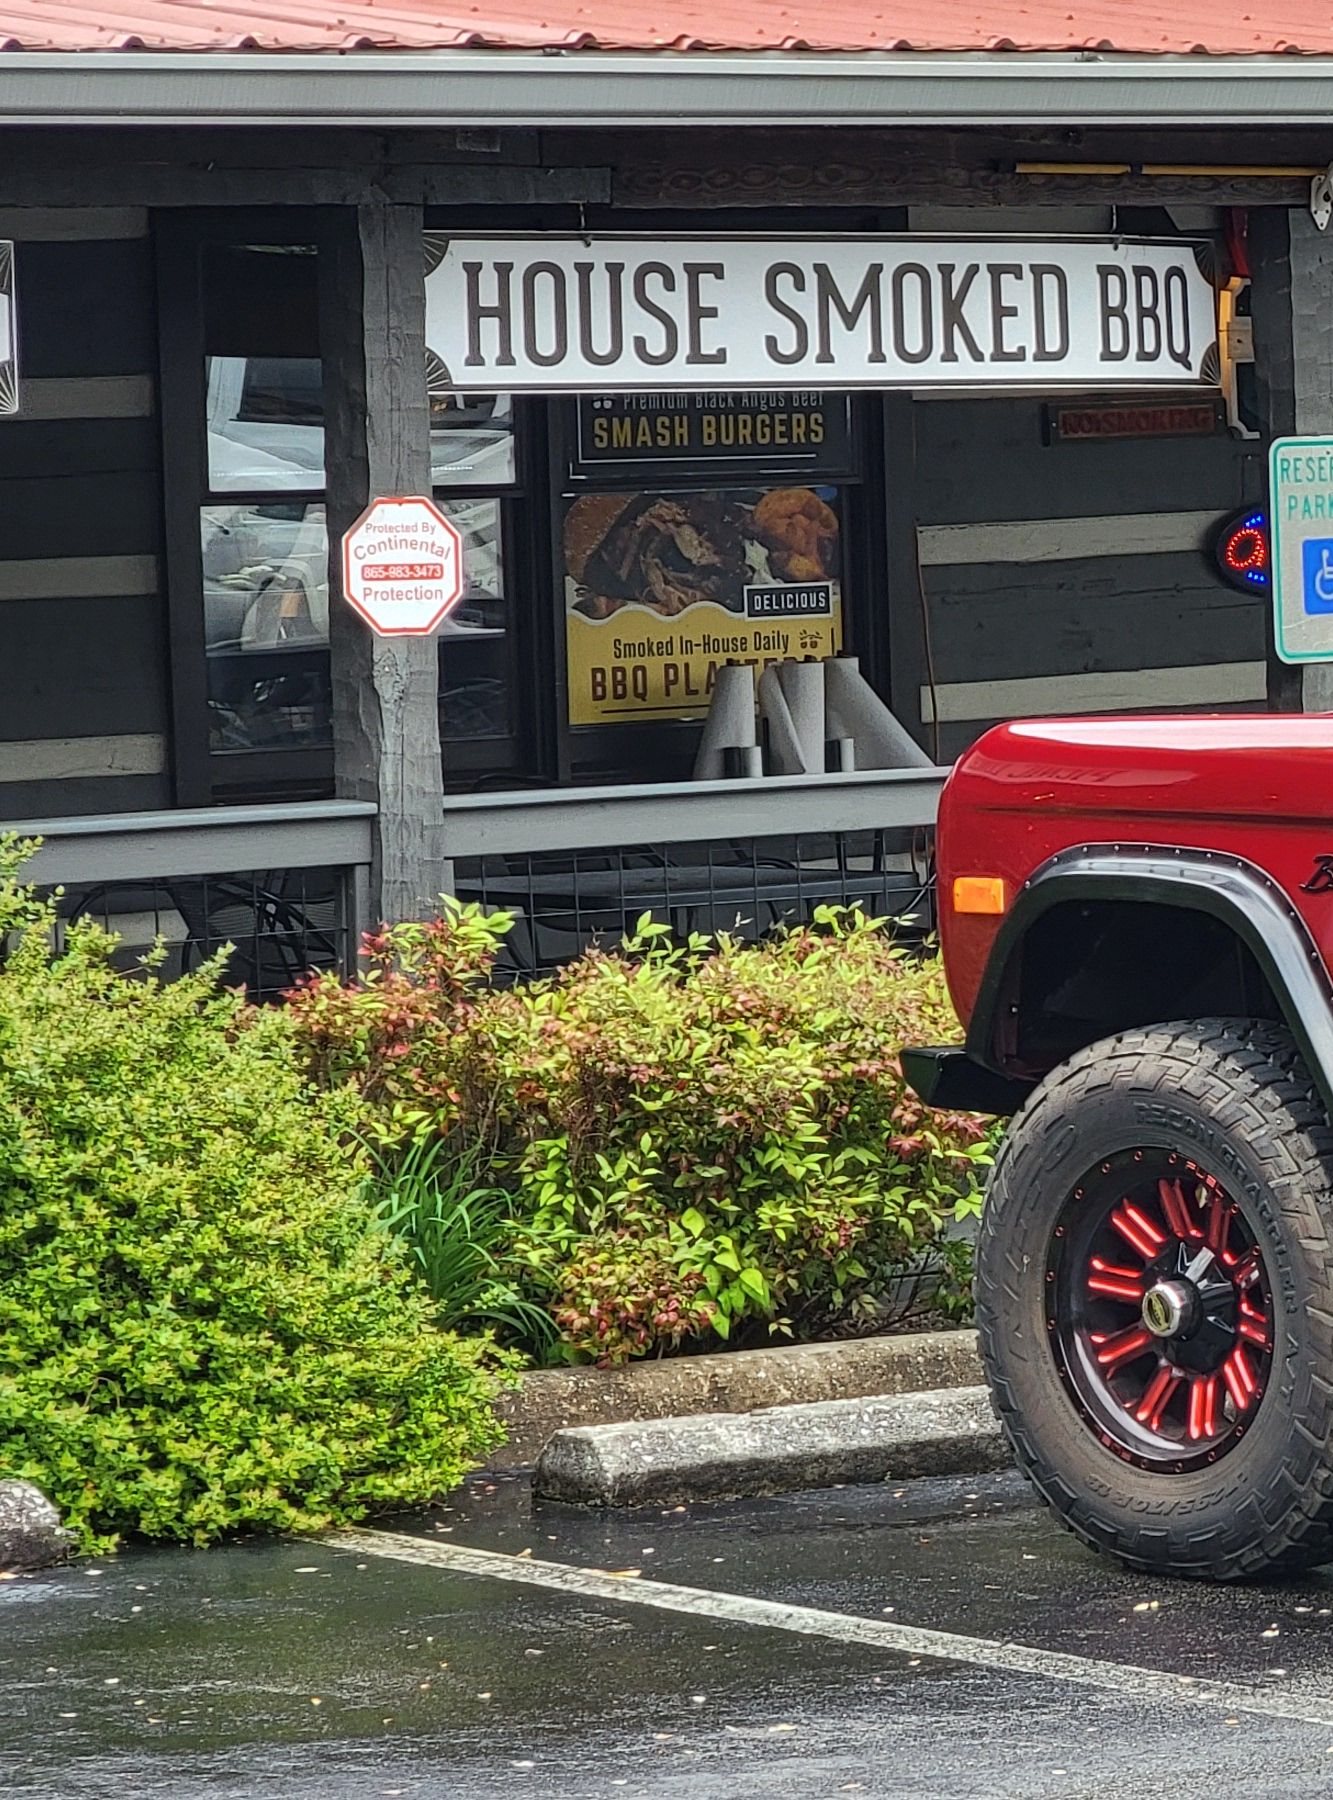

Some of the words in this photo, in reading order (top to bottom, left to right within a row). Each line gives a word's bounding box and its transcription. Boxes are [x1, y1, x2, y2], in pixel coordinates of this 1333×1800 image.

[462, 261, 728, 367] HOUSE
[764, 261, 1070, 365] SMOKED
[1097, 262, 1194, 371] BBQ
[624, 393, 688, 410] Premium
[696, 392, 735, 409] Black
[741, 391, 785, 411] Angus
[793, 391, 824, 406] Beef
[594, 415, 689, 448] SMASH
[702, 413, 825, 446] BURGERS
[365, 522, 419, 534] Protected
[421, 521, 437, 535] By
[354, 535, 451, 561] Continental
[363, 585, 443, 601] Protection
[754, 592, 826, 611] DELICIOUS
[613, 636, 674, 659] Smoked
[680, 633, 747, 655] In-House
[754, 630, 789, 655] Daily
[591, 665, 648, 701] BBQ
